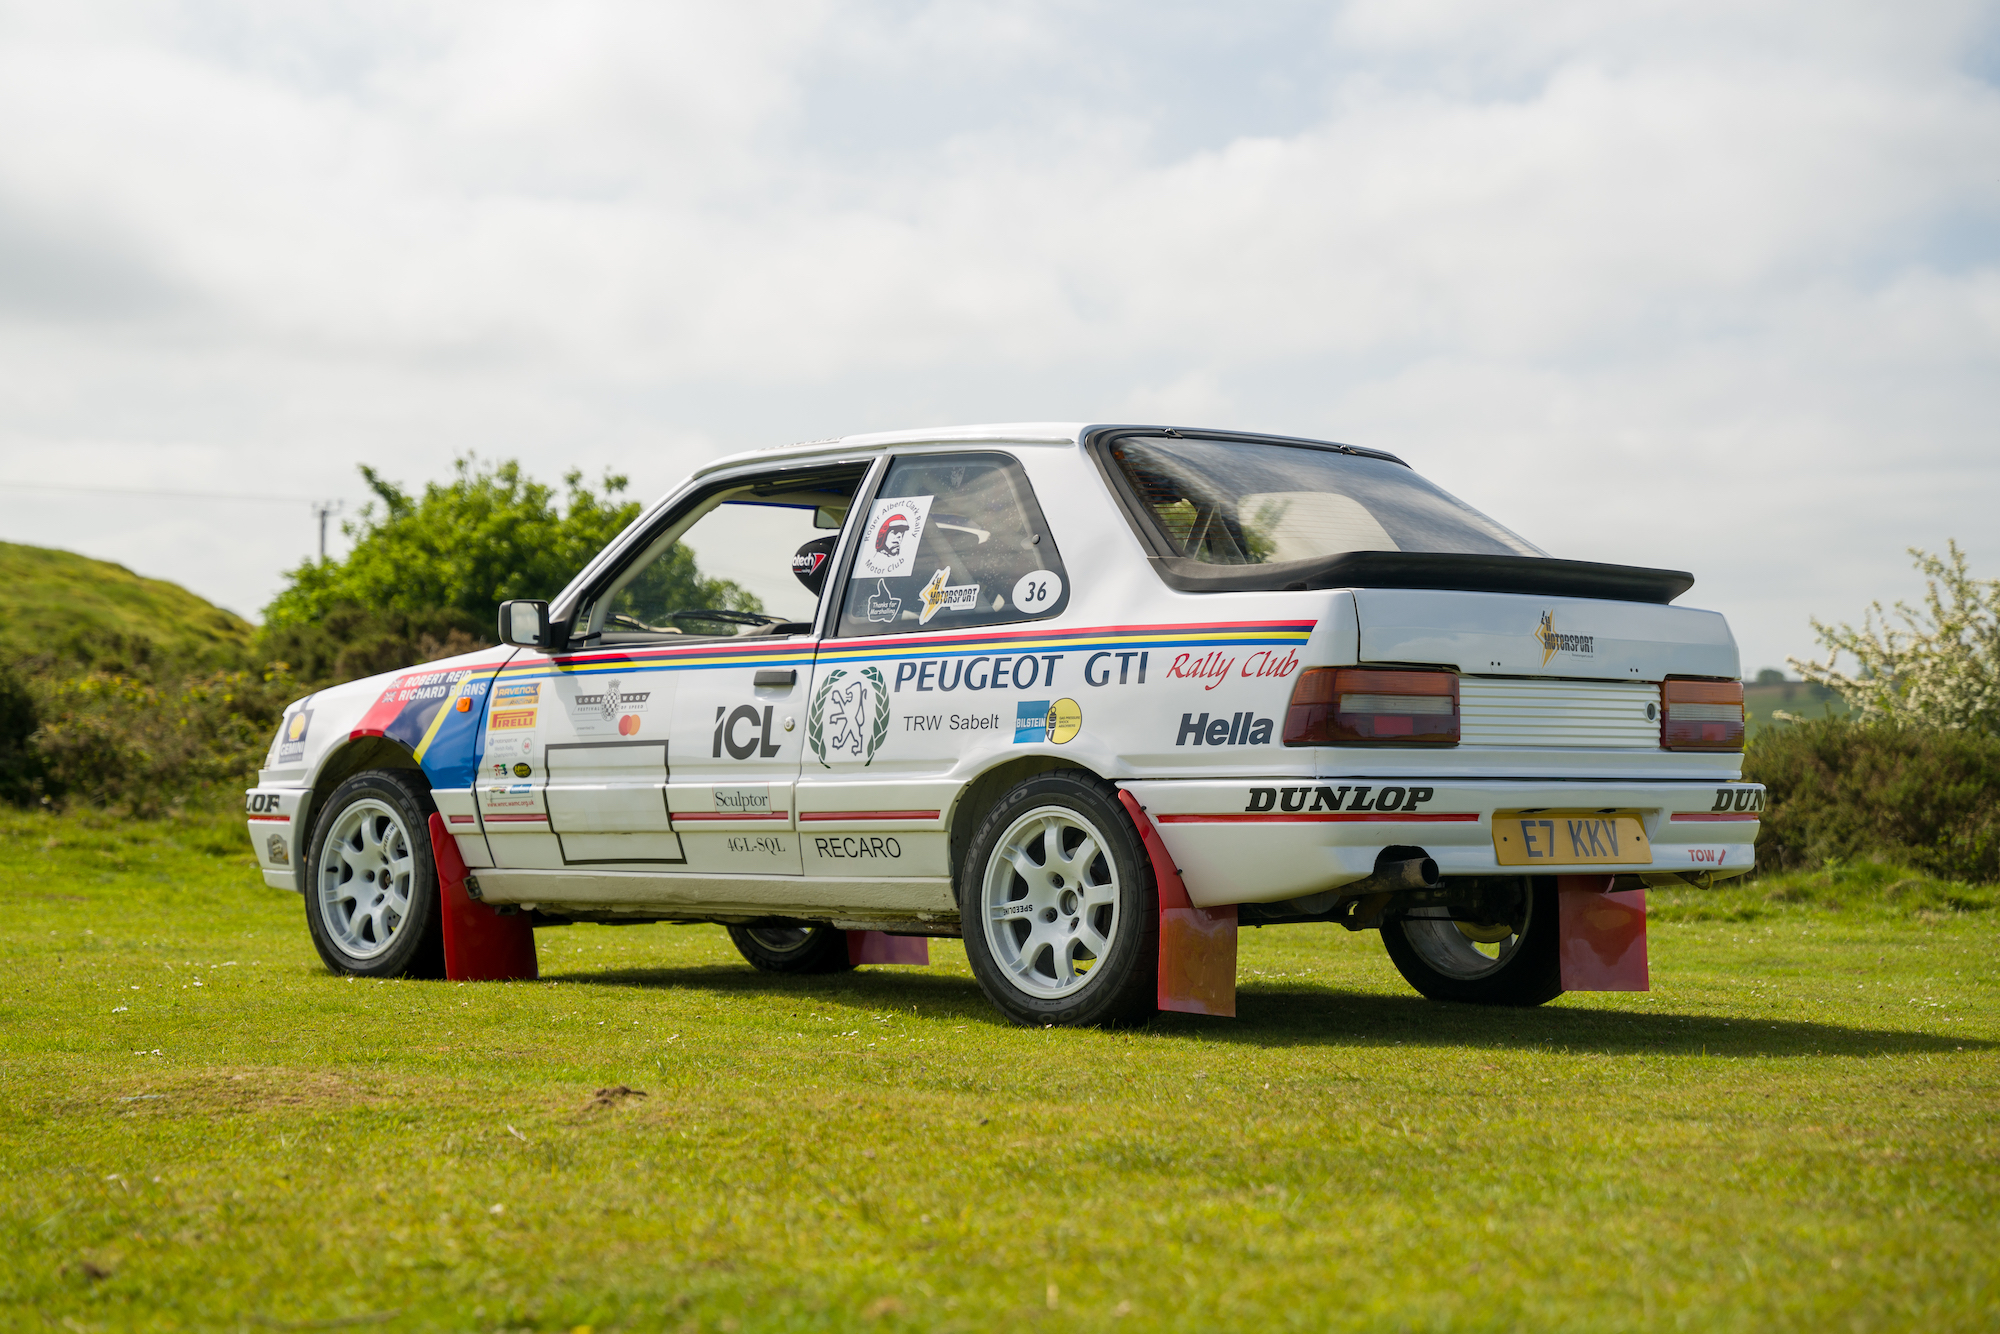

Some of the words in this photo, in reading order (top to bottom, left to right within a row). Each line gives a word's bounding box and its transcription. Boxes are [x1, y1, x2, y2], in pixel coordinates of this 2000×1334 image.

[882, 500, 905, 515] Albert
[906, 500, 920, 516] Clark
[864, 515, 880, 542] Roger
[912, 515, 921, 538] Rally
[865, 559, 886, 575] Motor
[887, 557, 905, 573] Club
[928, 587, 978, 606] MOTORSPORT
[1025, 581, 1047, 602] 36
[1544, 632, 1594, 653] MOTORSPORT
[404, 672, 446, 688] ROBERT
[446, 669, 472, 683] REID
[894, 654, 1064, 693] PEUGEOT
[1084, 651, 1149, 687] GTI
[1166, 650, 1236, 691] Rally
[1241, 648, 1299, 678] Club
[398, 685, 446, 702] RICHARD
[448, 682, 486, 698] BURNS
[498, 686, 537, 697] RAVENOL
[622, 693, 647, 703] WOOD
[577, 705, 601, 713] FESTIVAL
[628, 702, 645, 710] SPEED
[491, 711, 535, 729] PIRELLI
[903, 714, 943, 732] TRW
[949, 713, 1000, 731] Sabelt
[1016, 717, 1046, 728] BILSTEIN
[1175, 712, 1274, 746] Hella
[712, 704, 782, 760] ICL
[280, 740, 305, 756] GEMINI
[714, 791, 768, 812] Sculptor
[1244, 786, 1434, 812] DUNLOP
[726, 837, 786, 856] 4GL-SQL
[814, 837, 902, 859] RECARO
[1520, 819, 1555, 858] E7
[1567, 819, 1619, 858] KKV
[1687, 849, 1715, 862] TOW
